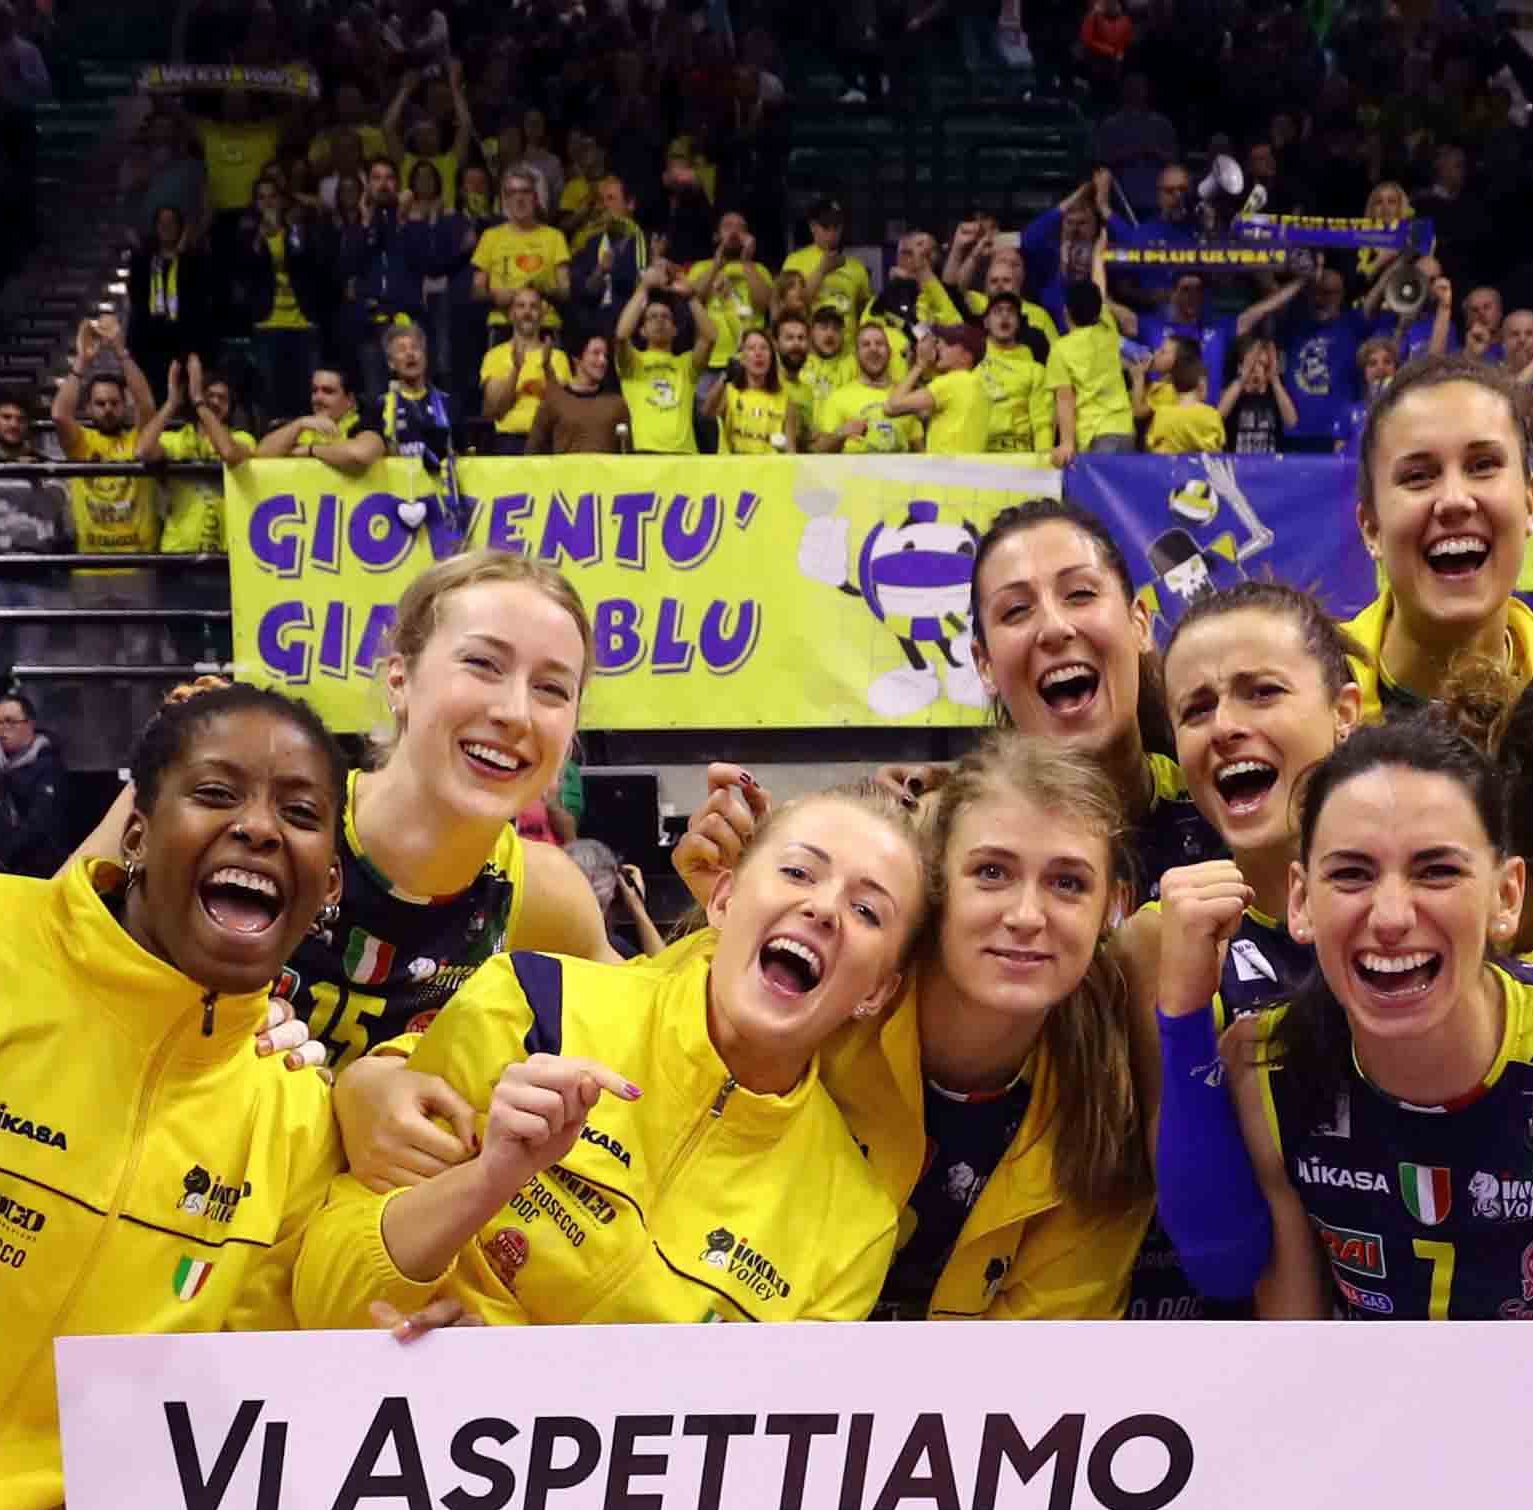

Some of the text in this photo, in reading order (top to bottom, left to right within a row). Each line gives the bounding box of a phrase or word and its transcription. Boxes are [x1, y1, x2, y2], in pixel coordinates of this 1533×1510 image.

[579, 1126, 632, 1169] KASA
[509, 1190, 542, 1224] DOC
[525, 1175, 588, 1248] PROSECCO
[1411, 1238, 1456, 1320] 7
